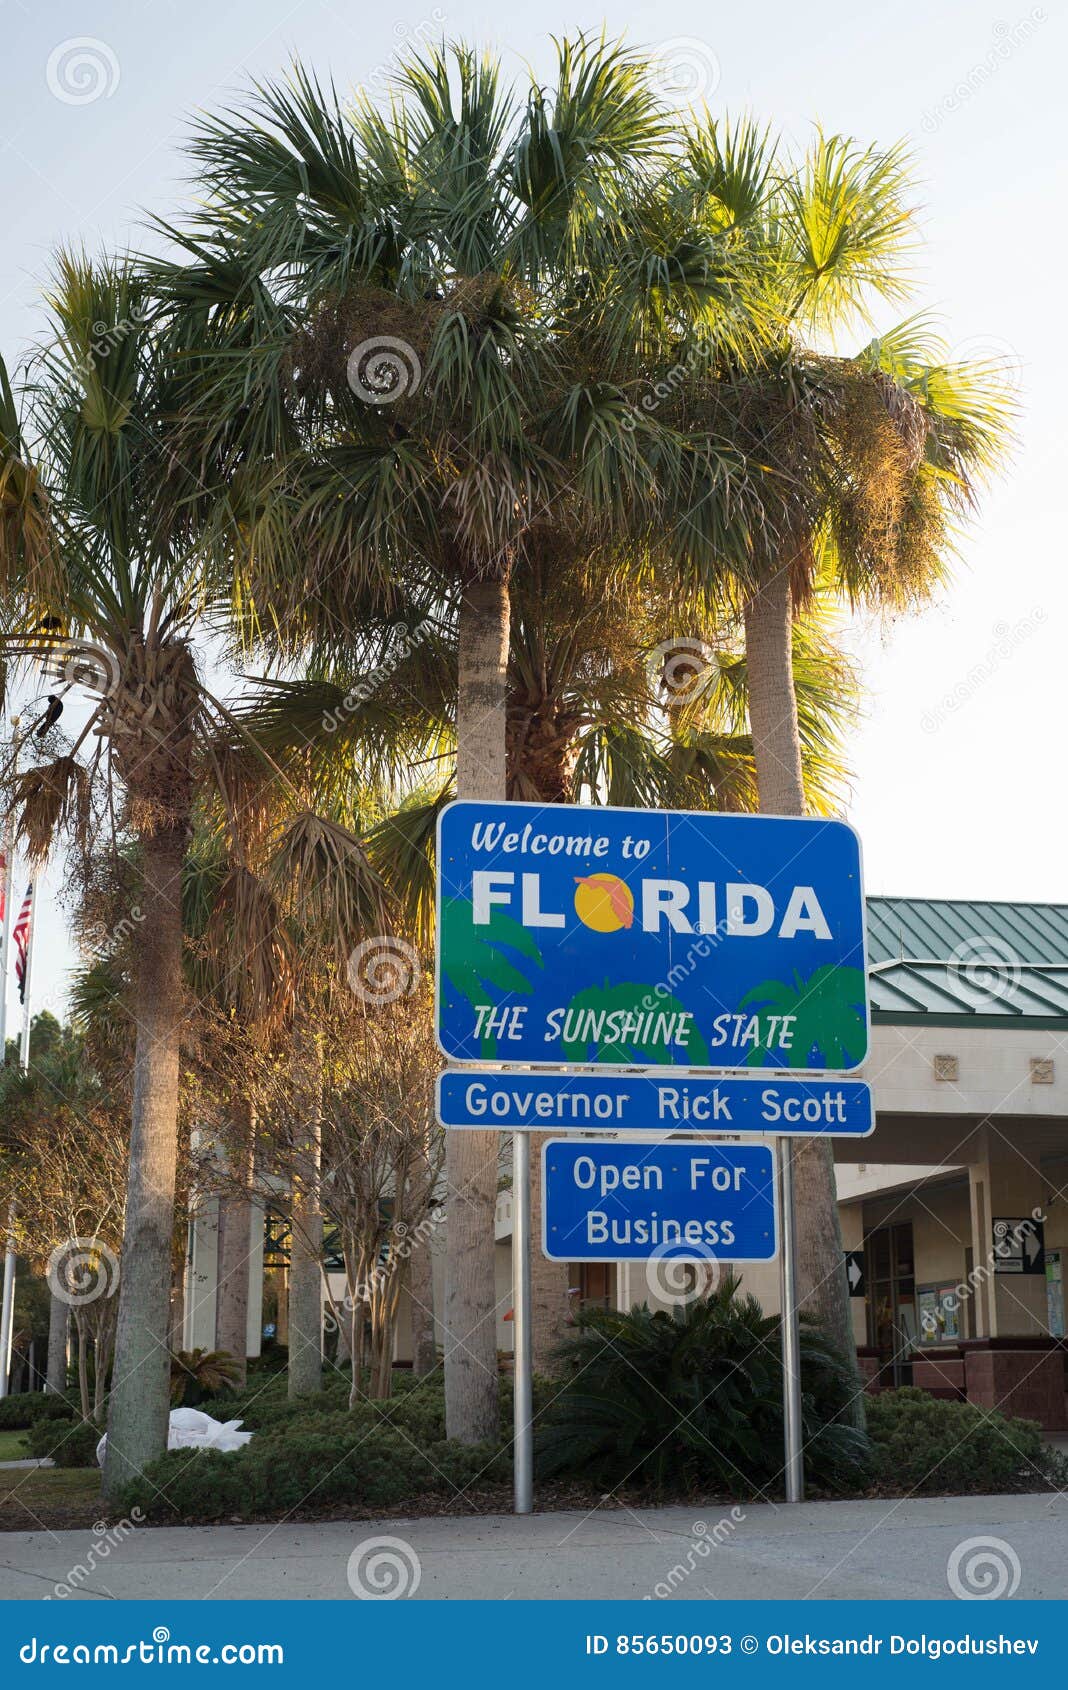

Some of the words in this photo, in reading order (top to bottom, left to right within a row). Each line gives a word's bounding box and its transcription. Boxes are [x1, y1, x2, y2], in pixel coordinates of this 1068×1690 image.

[471, 822, 609, 857] Welcome
[622, 836, 650, 859] to
[472, 870, 833, 940] FLORIDA
[474, 1005, 528, 1040] THE
[545, 1008, 693, 1046] SUNSHINE
[712, 1013, 797, 1049] STATE
[465, 1083, 630, 1118] Governor
[658, 1087, 732, 1121] Rick
[761, 1090, 847, 1123] Scott
[573, 1156, 663, 1196] Open
[690, 1158, 746, 1191] For
[587, 1211, 735, 1245] Business
